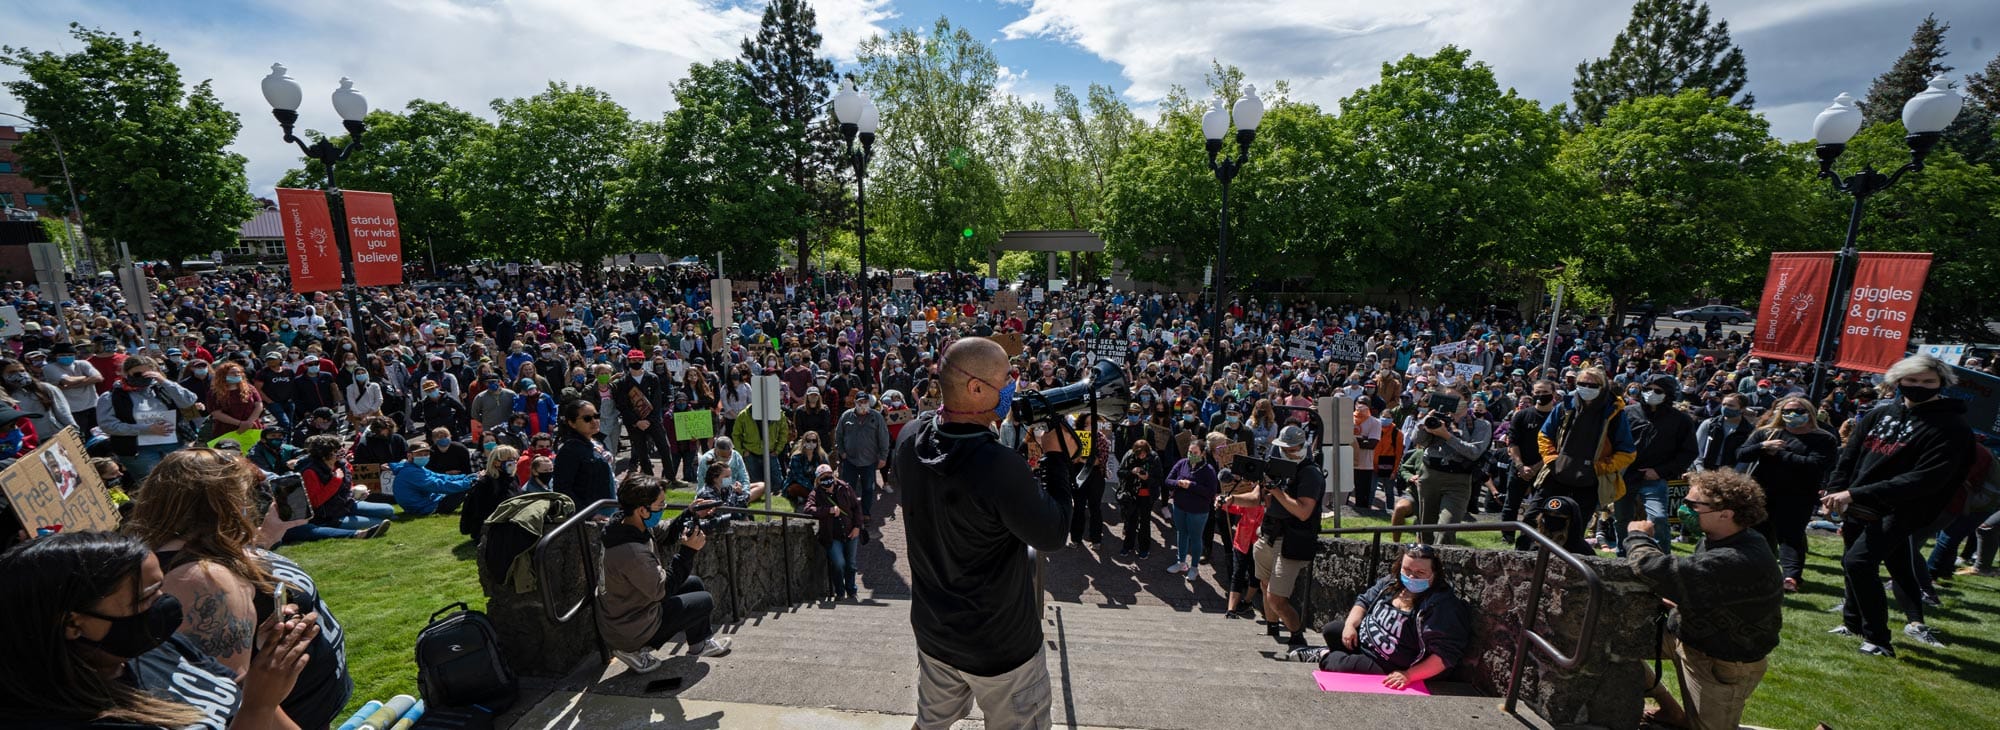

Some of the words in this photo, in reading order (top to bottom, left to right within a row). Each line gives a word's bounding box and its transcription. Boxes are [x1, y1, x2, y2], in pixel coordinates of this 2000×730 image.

[292, 208, 303, 235] Project
[351, 216, 380, 225] stand
[382, 217, 395, 226] up
[353, 228, 369, 237] for
[370, 229, 396, 237] what
[297, 238, 306, 253] JOY
[367, 240, 386, 250] you
[300, 255, 309, 274] Bend
[357, 252, 398, 262] believe
[1774, 272, 1788, 300] Project
[1854, 285, 1913, 302] giggles
[1770, 301, 1781, 319] JOY
[1850, 304, 1862, 317] &
[1866, 307, 1907, 322] grins
[1766, 320, 1778, 340] Bend
[1846, 325, 1870, 336] are
[1872, 325, 1902, 339] free
[1332, 344, 1347, 352] KILL
[1348, 345, 1364, 354] YOU
[2, 472, 53, 522] Free
[1373, 599, 1408, 638] LACK
